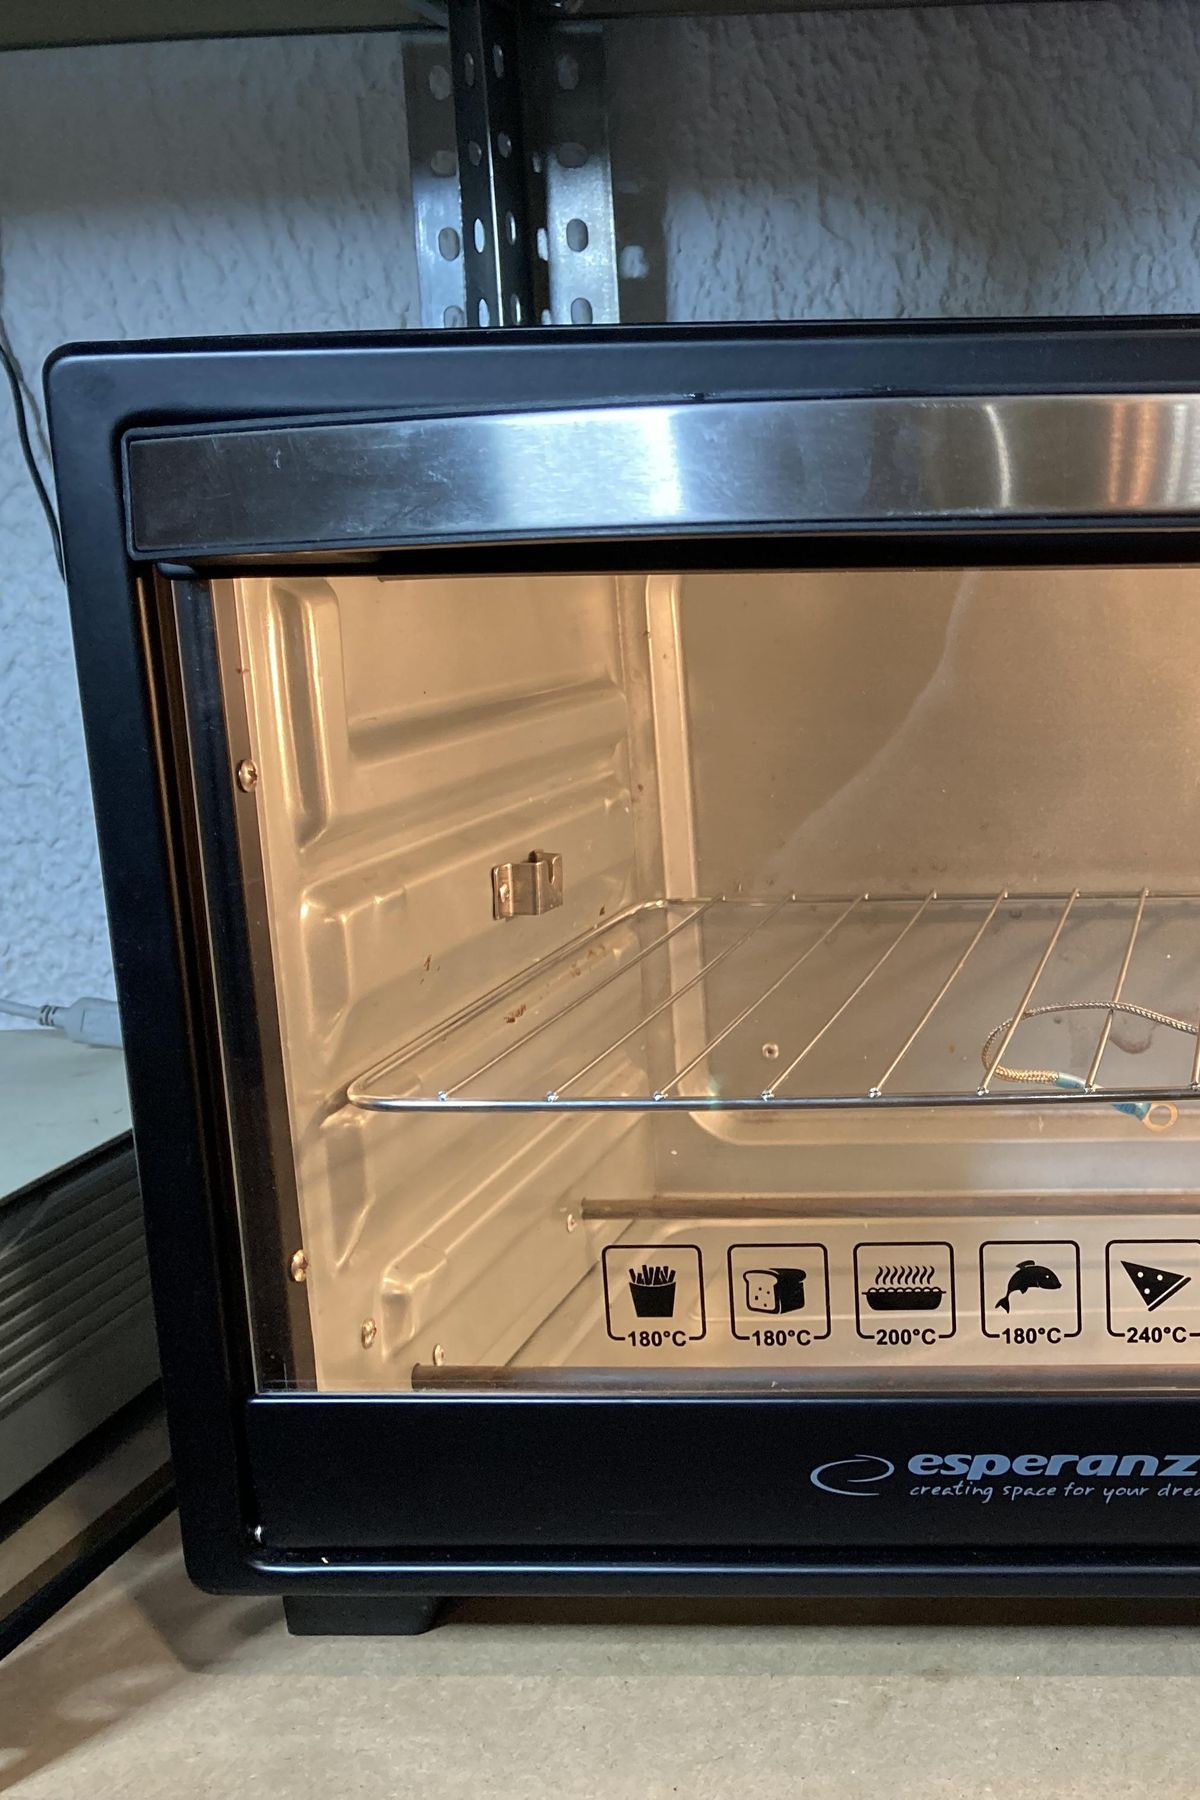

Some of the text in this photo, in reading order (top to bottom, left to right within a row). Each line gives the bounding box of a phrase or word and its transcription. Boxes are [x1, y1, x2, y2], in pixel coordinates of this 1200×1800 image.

[626, 1331, 687, 1347] 180°C
[751, 1331, 811, 1346] 180°C
[876, 1330, 936, 1346] 200°C
[1001, 1328, 1062, 1344] 180°C
[1126, 1327, 1188, 1343] 240°C
[909, 1481, 994, 1503] creating
[1002, 1485, 1057, 1501] space
[1064, 1482, 1095, 1499] for
[1102, 1484, 1150, 1503] your
